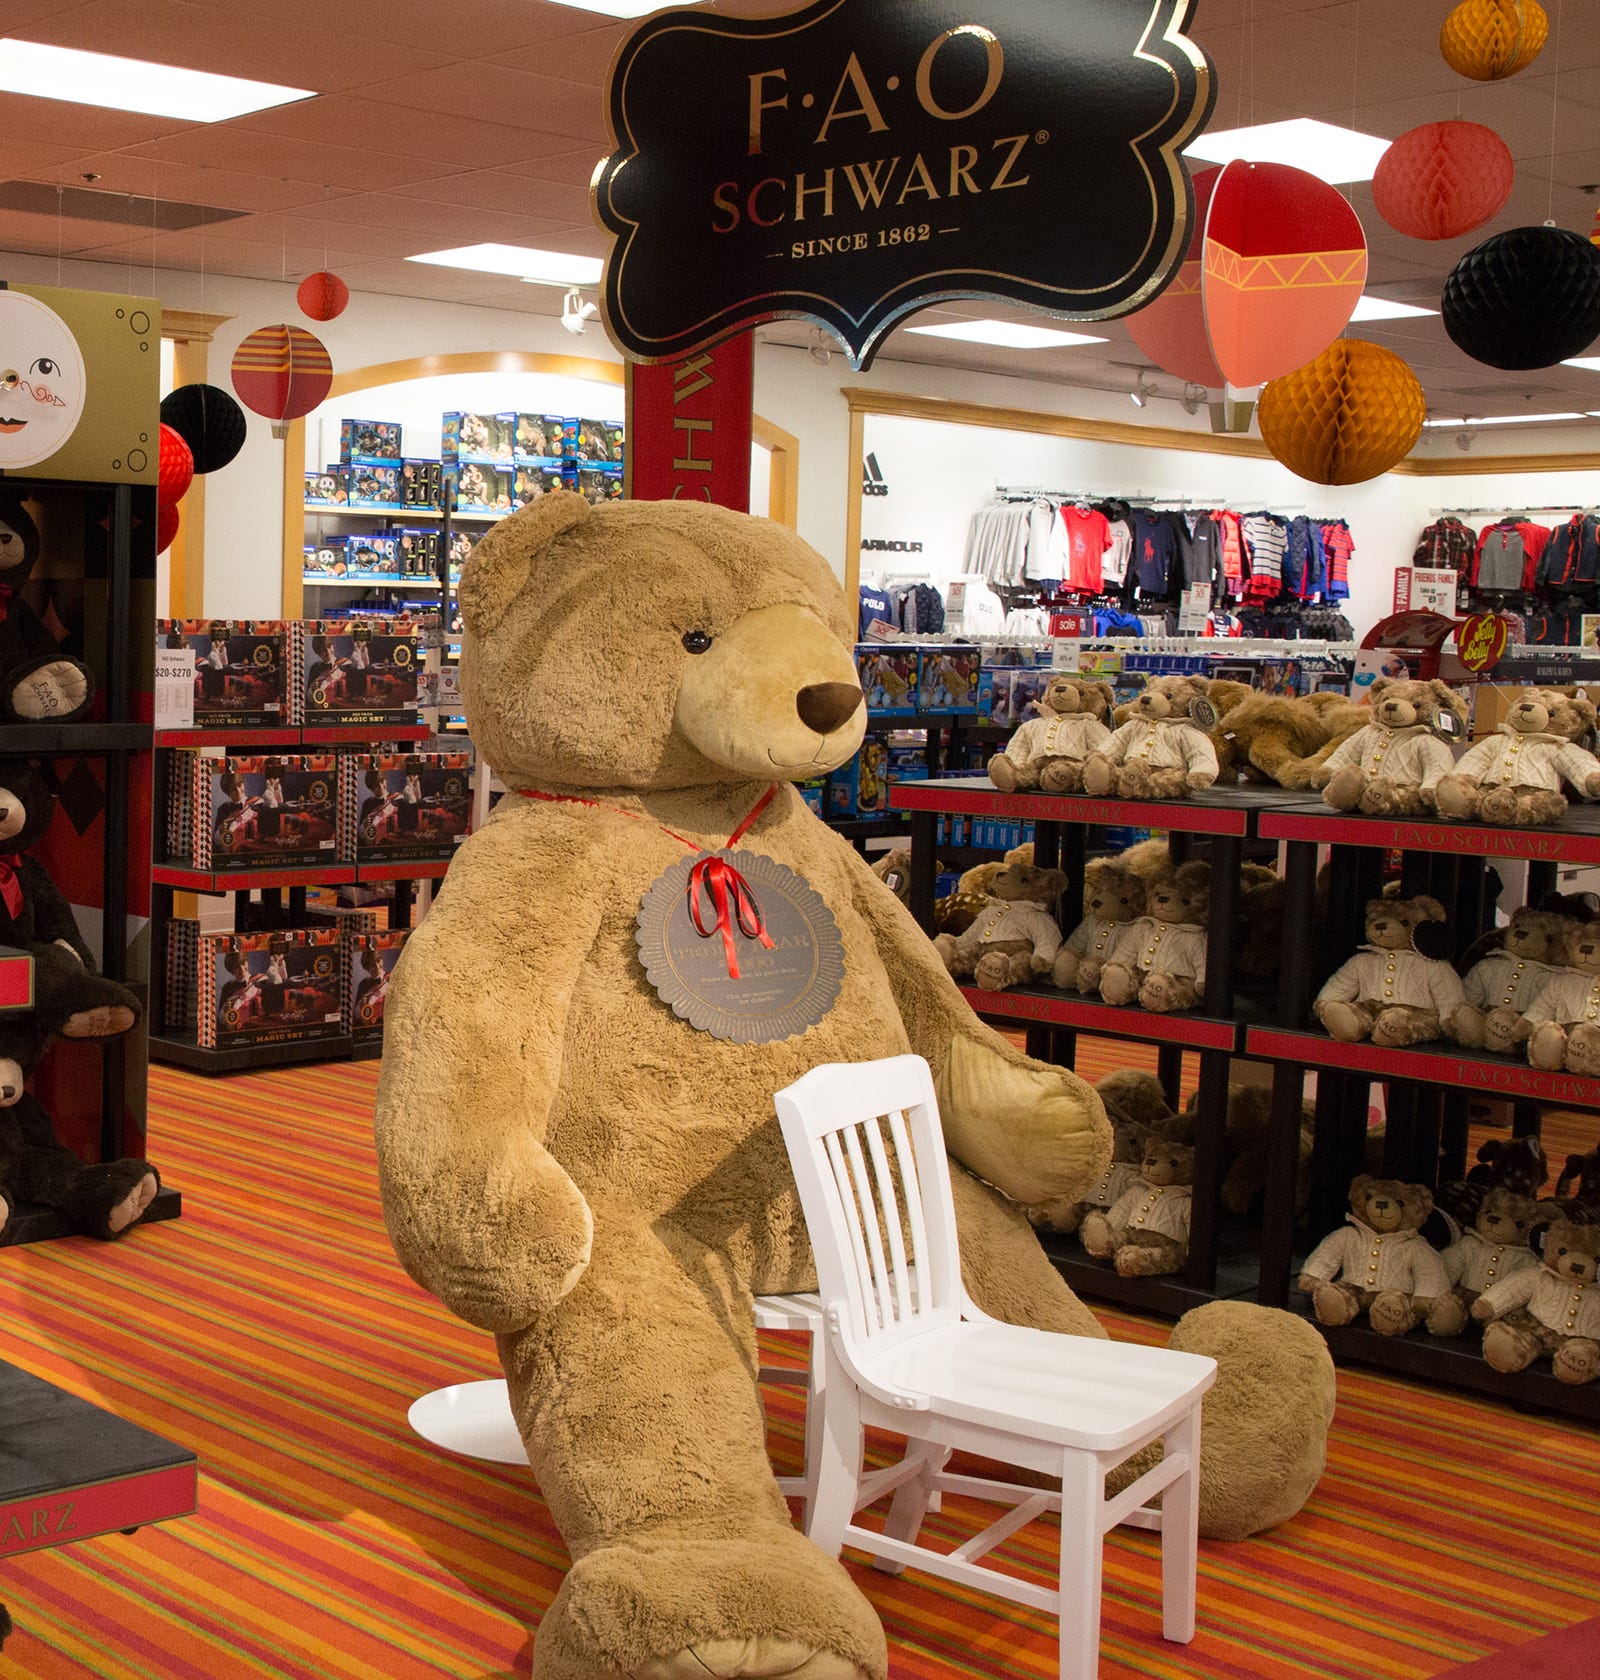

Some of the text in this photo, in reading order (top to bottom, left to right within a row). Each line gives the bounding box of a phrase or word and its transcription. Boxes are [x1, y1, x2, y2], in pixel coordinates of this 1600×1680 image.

[791, 223, 931, 260] SINCE 1862
[862, 539, 923, 552] ARMOUR
[1396, 570, 1409, 605] FAMILY
[863, 598, 885, 610] POLO
[1059, 619, 1076, 631] sale
[1474, 614, 1496, 645] Jelly
[1464, 640, 1490, 671] Belly
[155, 667, 191, 678] $20-$270
